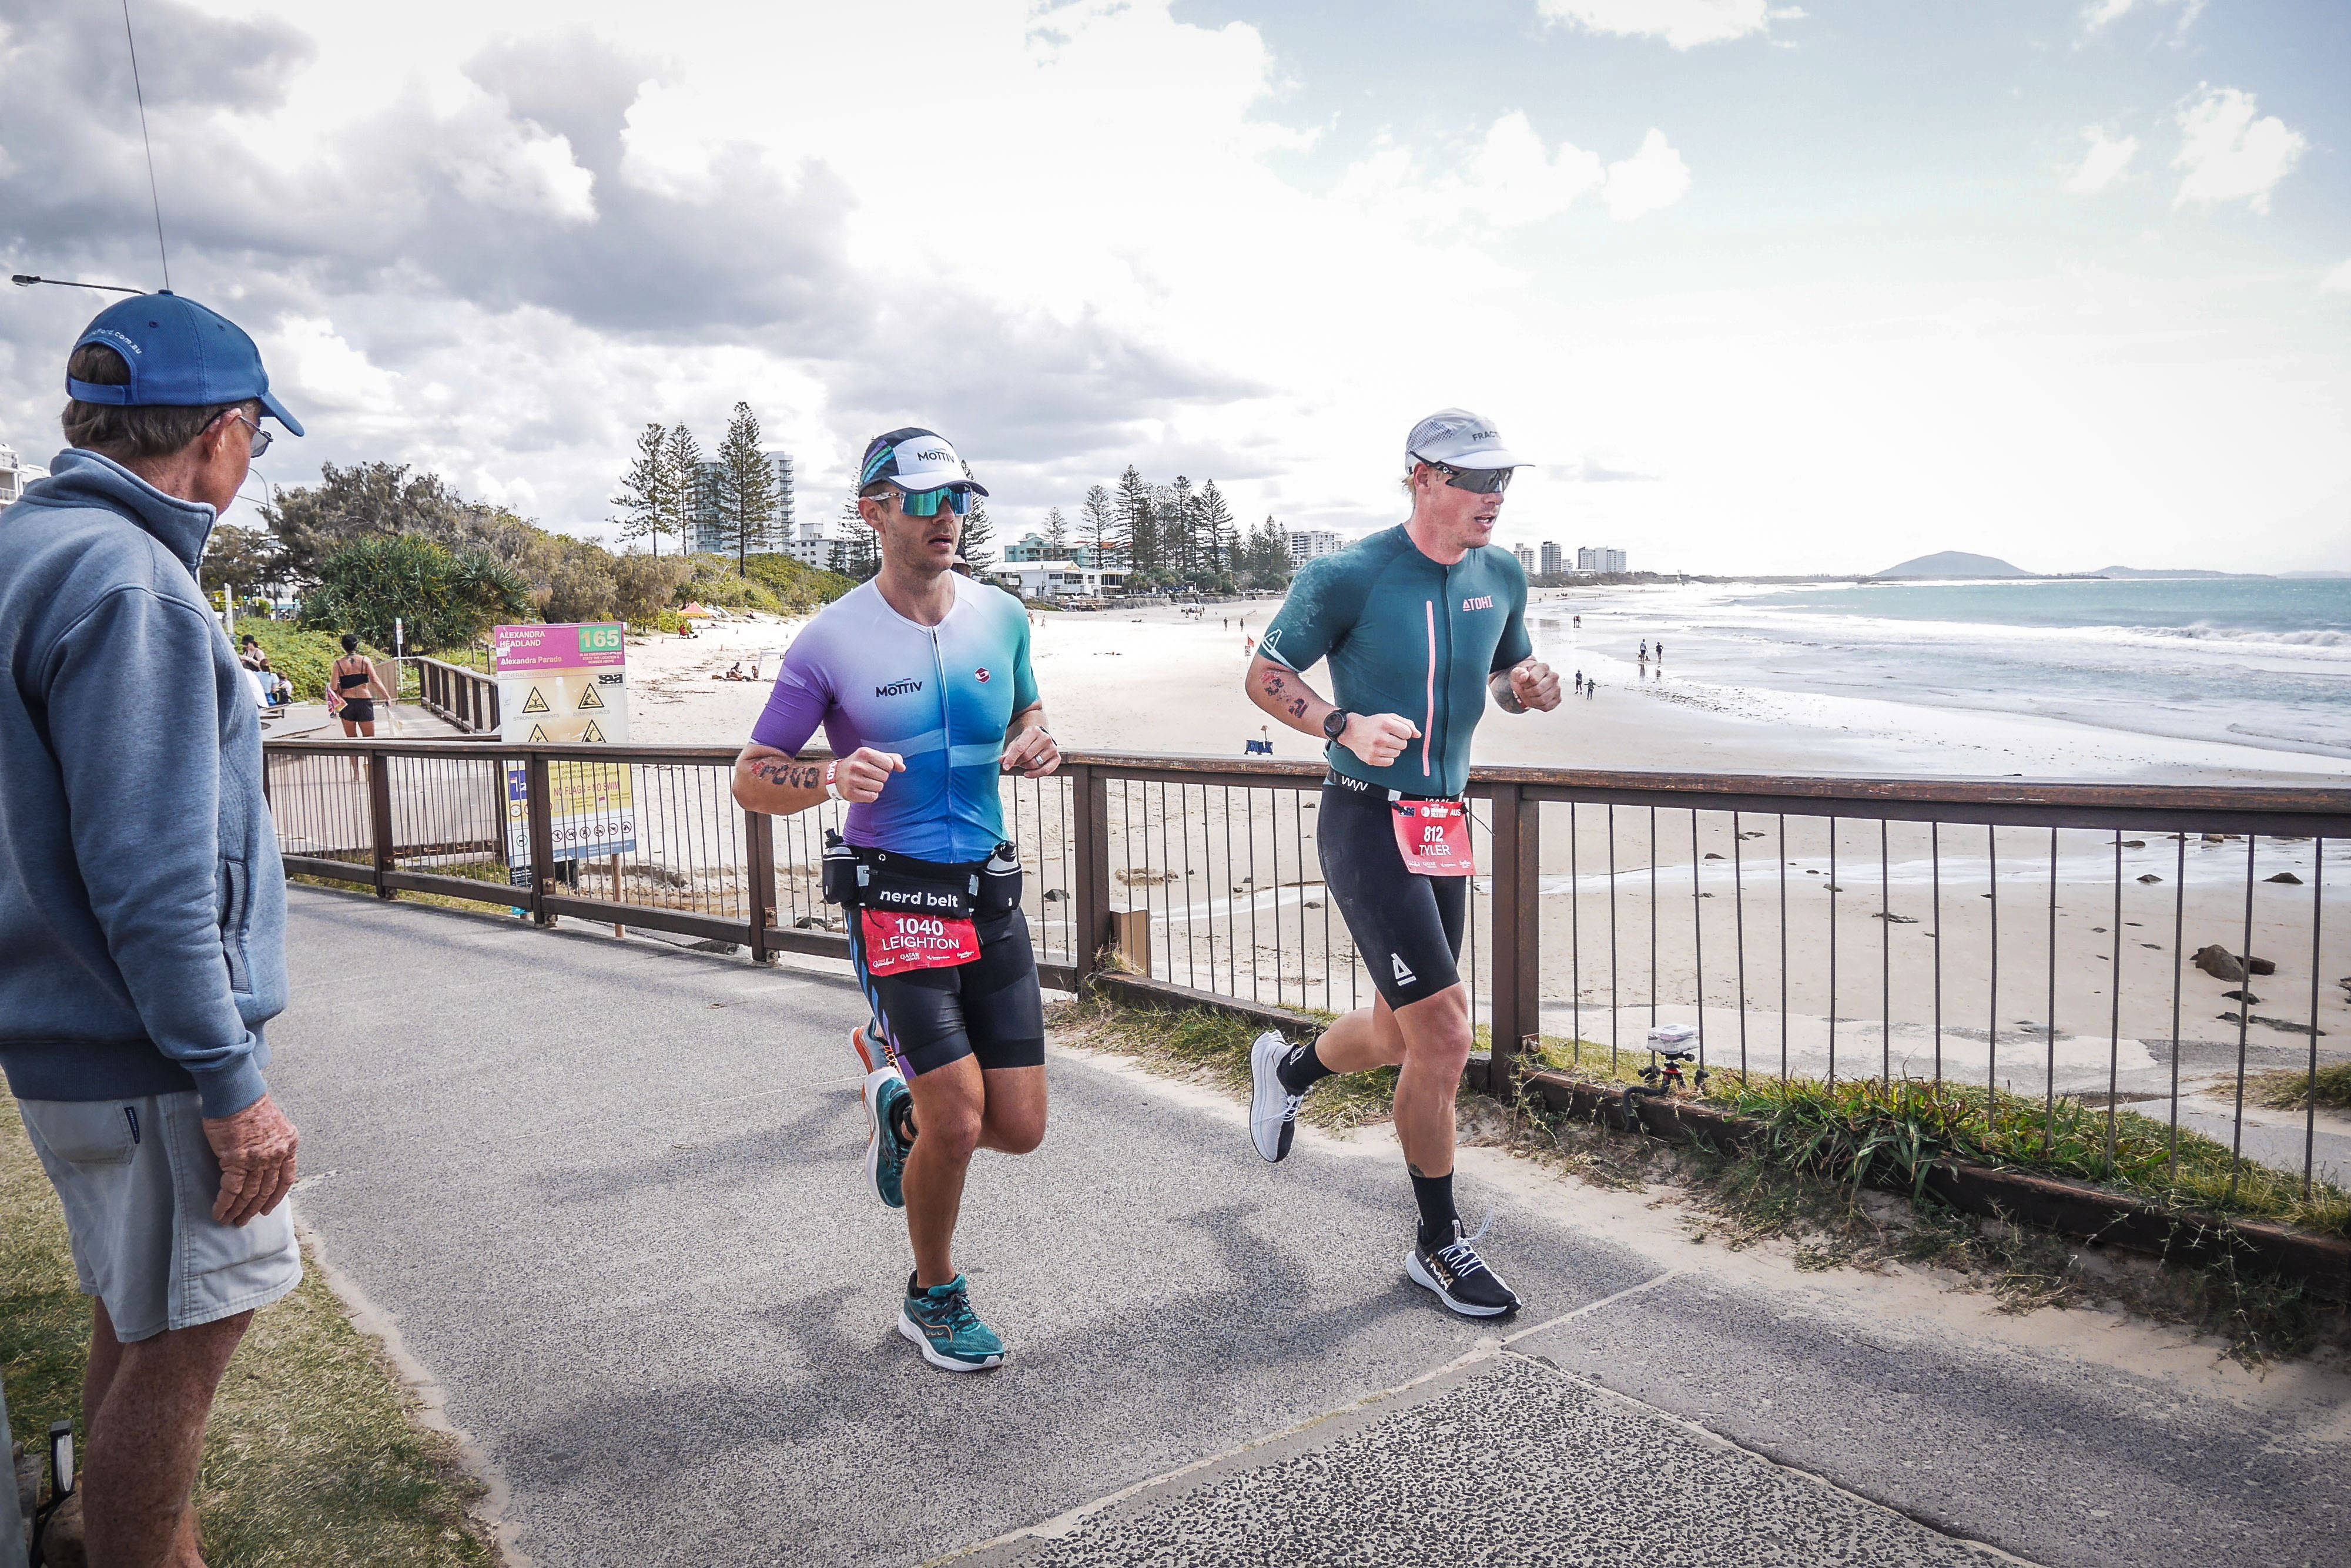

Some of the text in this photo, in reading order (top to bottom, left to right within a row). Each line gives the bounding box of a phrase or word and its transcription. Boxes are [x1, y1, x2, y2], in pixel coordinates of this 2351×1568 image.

[500, 631, 545, 639] ALEXANDRA
[581, 630, 619, 647] 165
[565, 785, 585, 795] FLAGS
[1424, 825, 1444, 842] 812
[1418, 844, 1452, 856] TYLER
[880, 890, 958, 907] nerd belt
[895, 917, 944, 936] 1040
[882, 935, 960, 951] LEIGHTON
